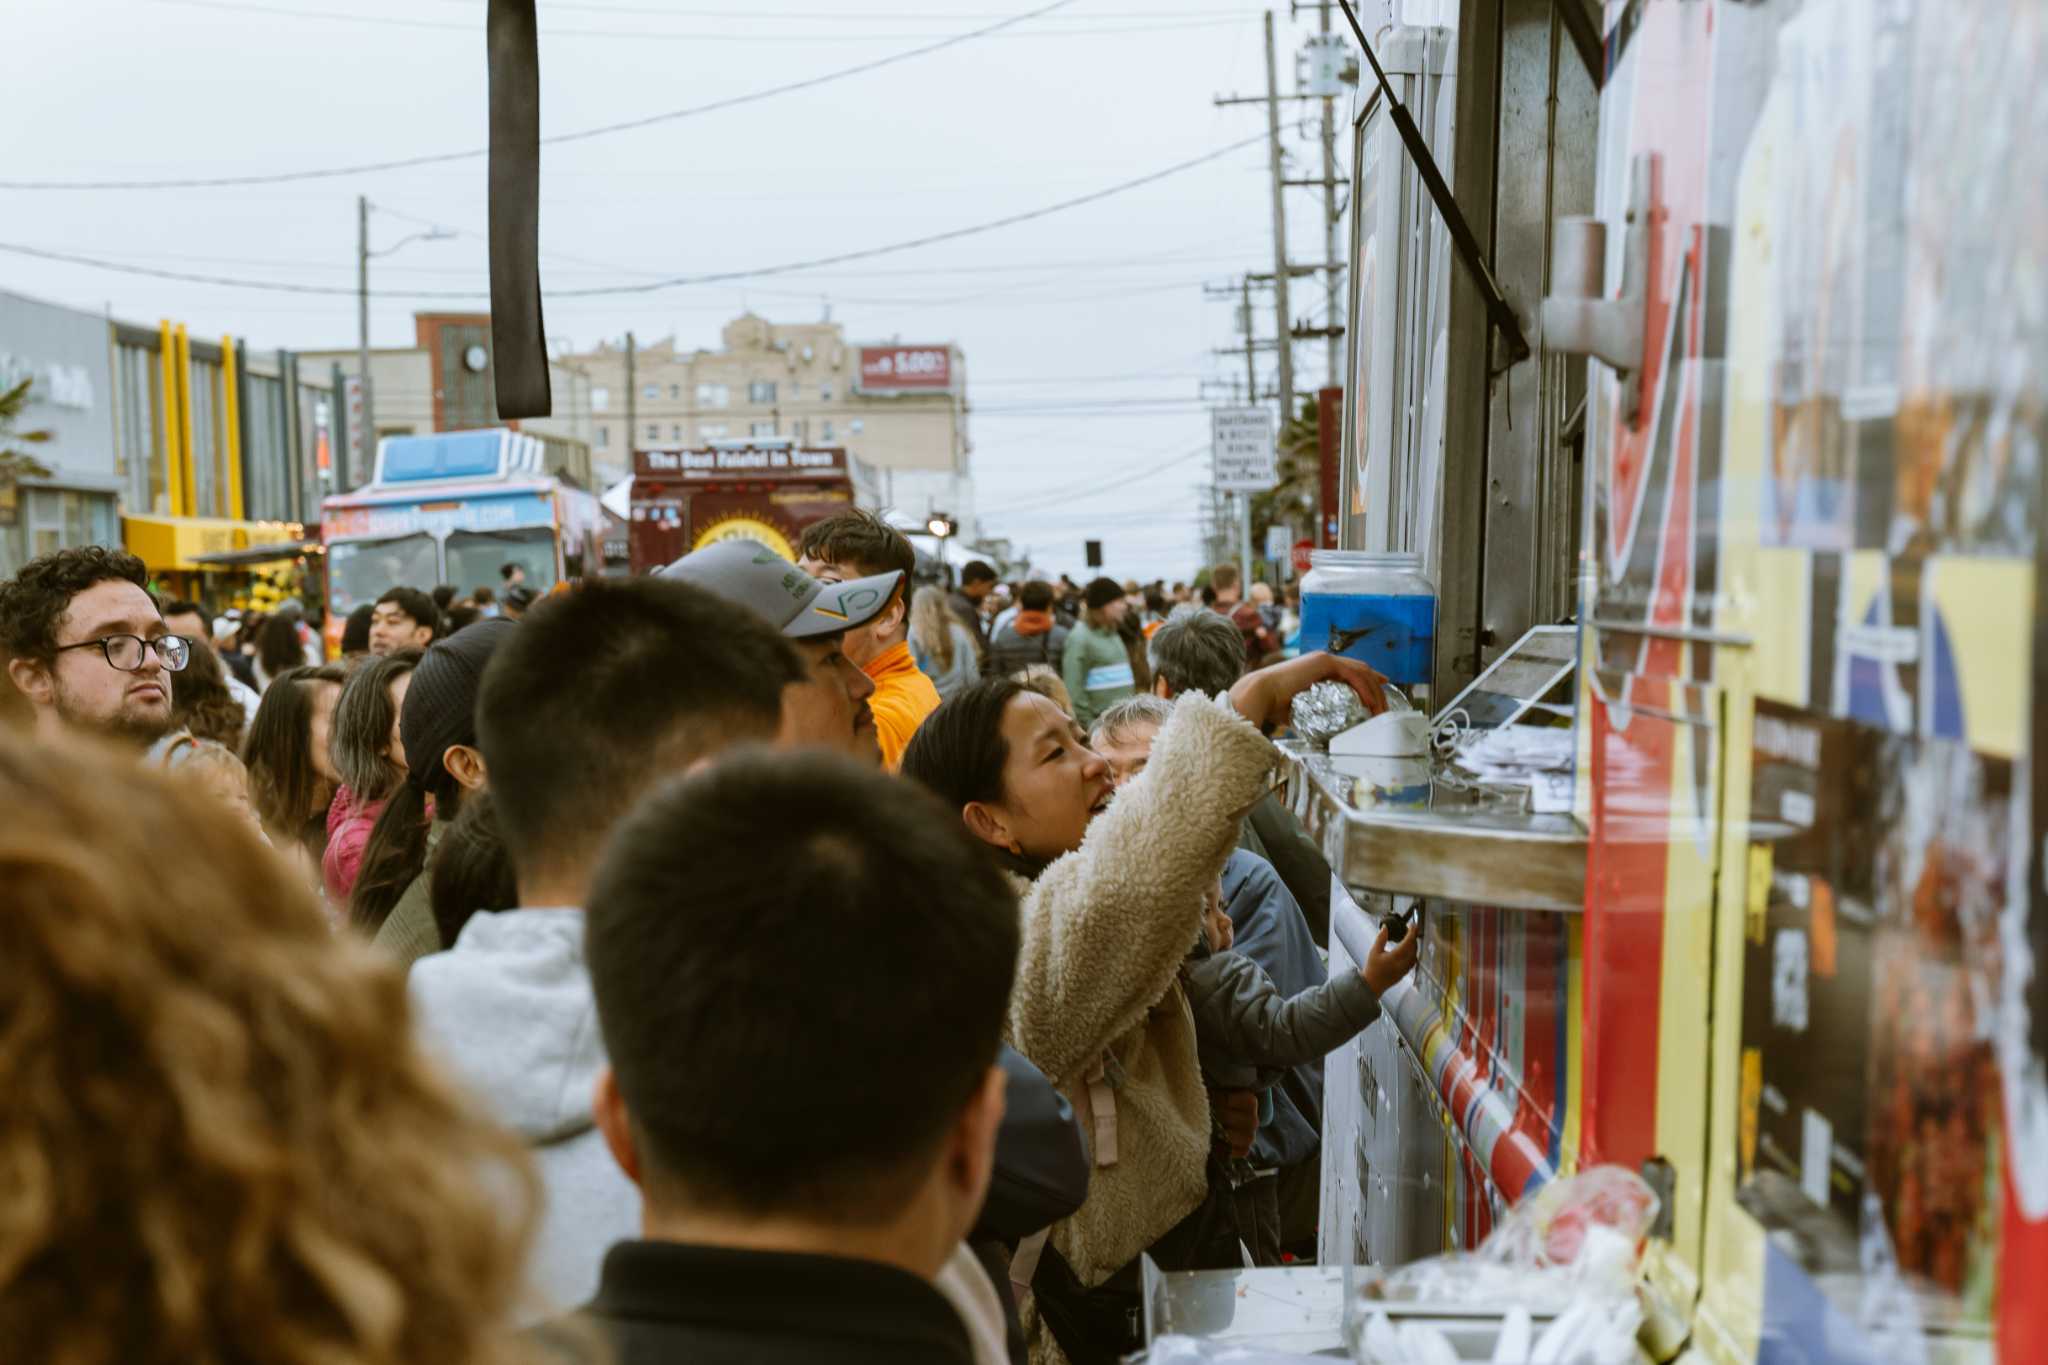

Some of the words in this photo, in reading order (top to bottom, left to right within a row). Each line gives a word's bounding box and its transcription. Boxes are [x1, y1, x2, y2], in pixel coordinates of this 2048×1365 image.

[649, 451, 678, 468] The
[681, 451, 714, 468] Best
[791, 450, 833, 466] Town
